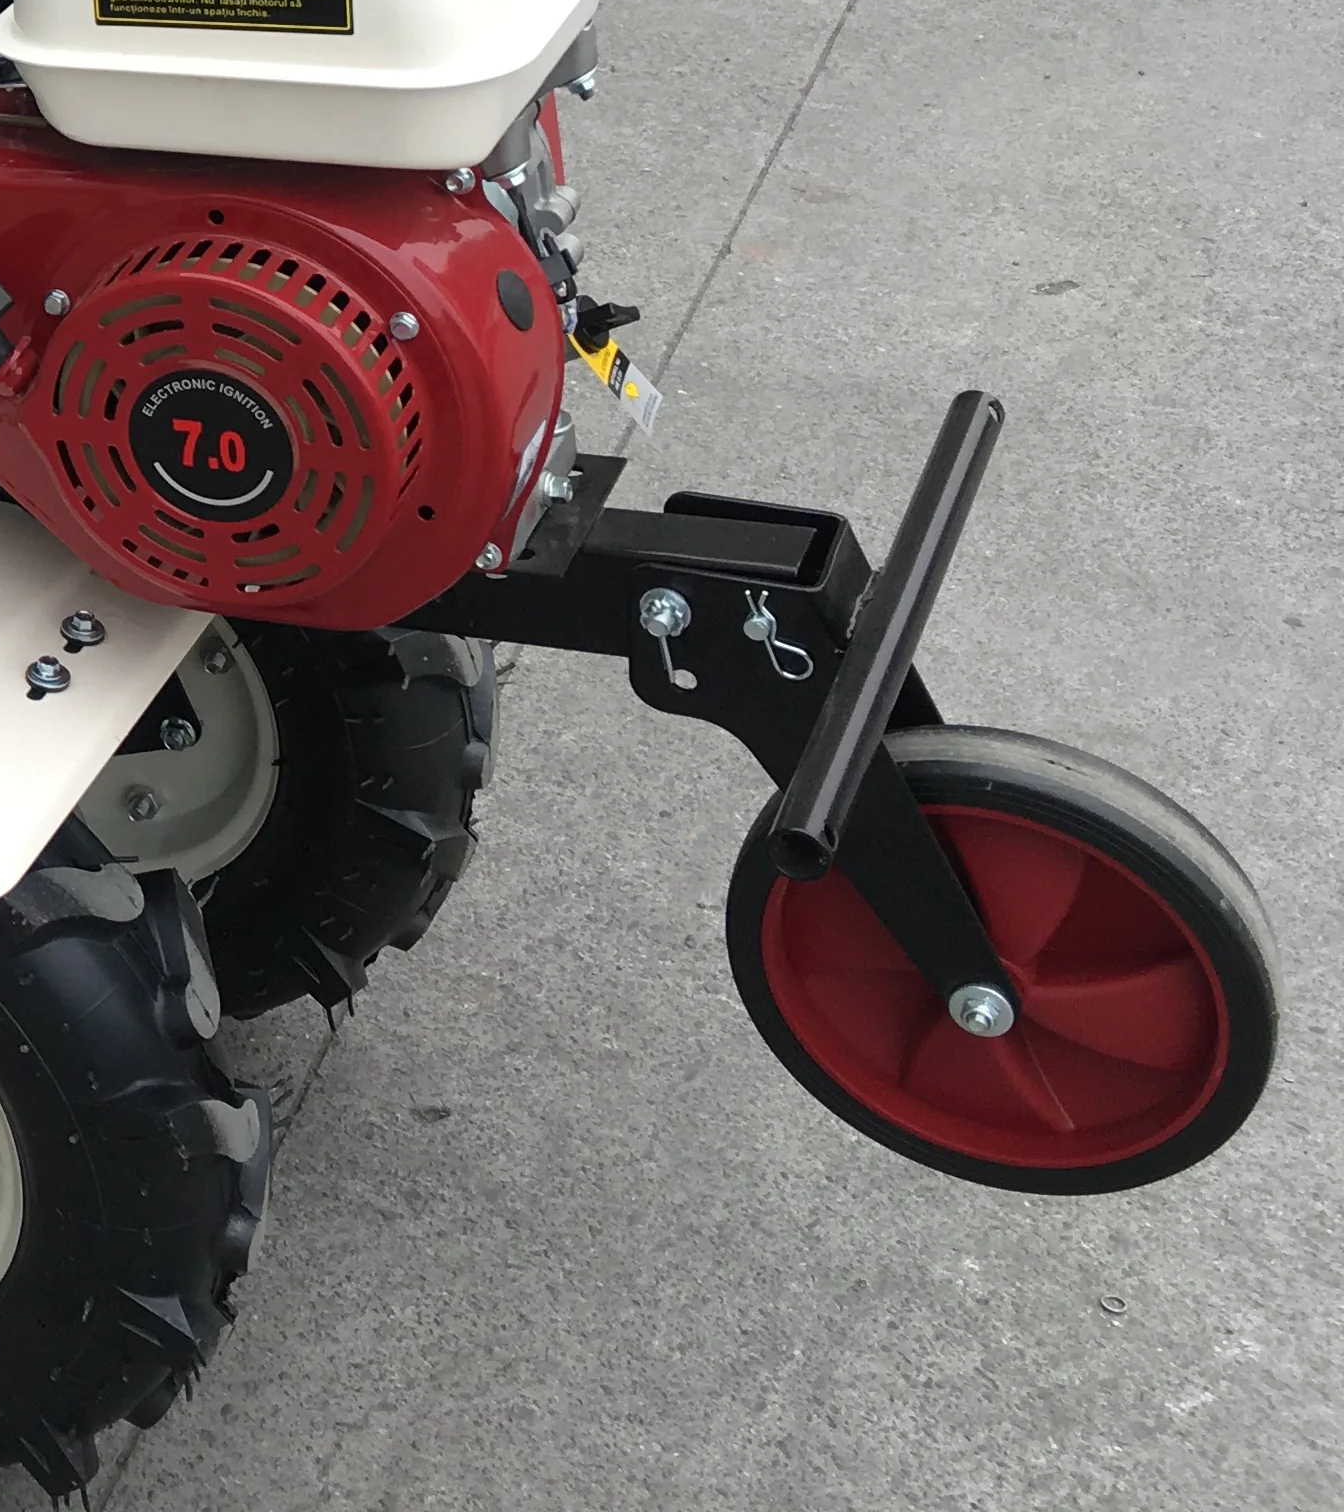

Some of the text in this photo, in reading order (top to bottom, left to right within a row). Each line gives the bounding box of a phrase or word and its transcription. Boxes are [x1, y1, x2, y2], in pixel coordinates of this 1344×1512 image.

[141, 378, 273, 429] ELECTRONIC IGNITION
[172, 418, 246, 473] 7.0
